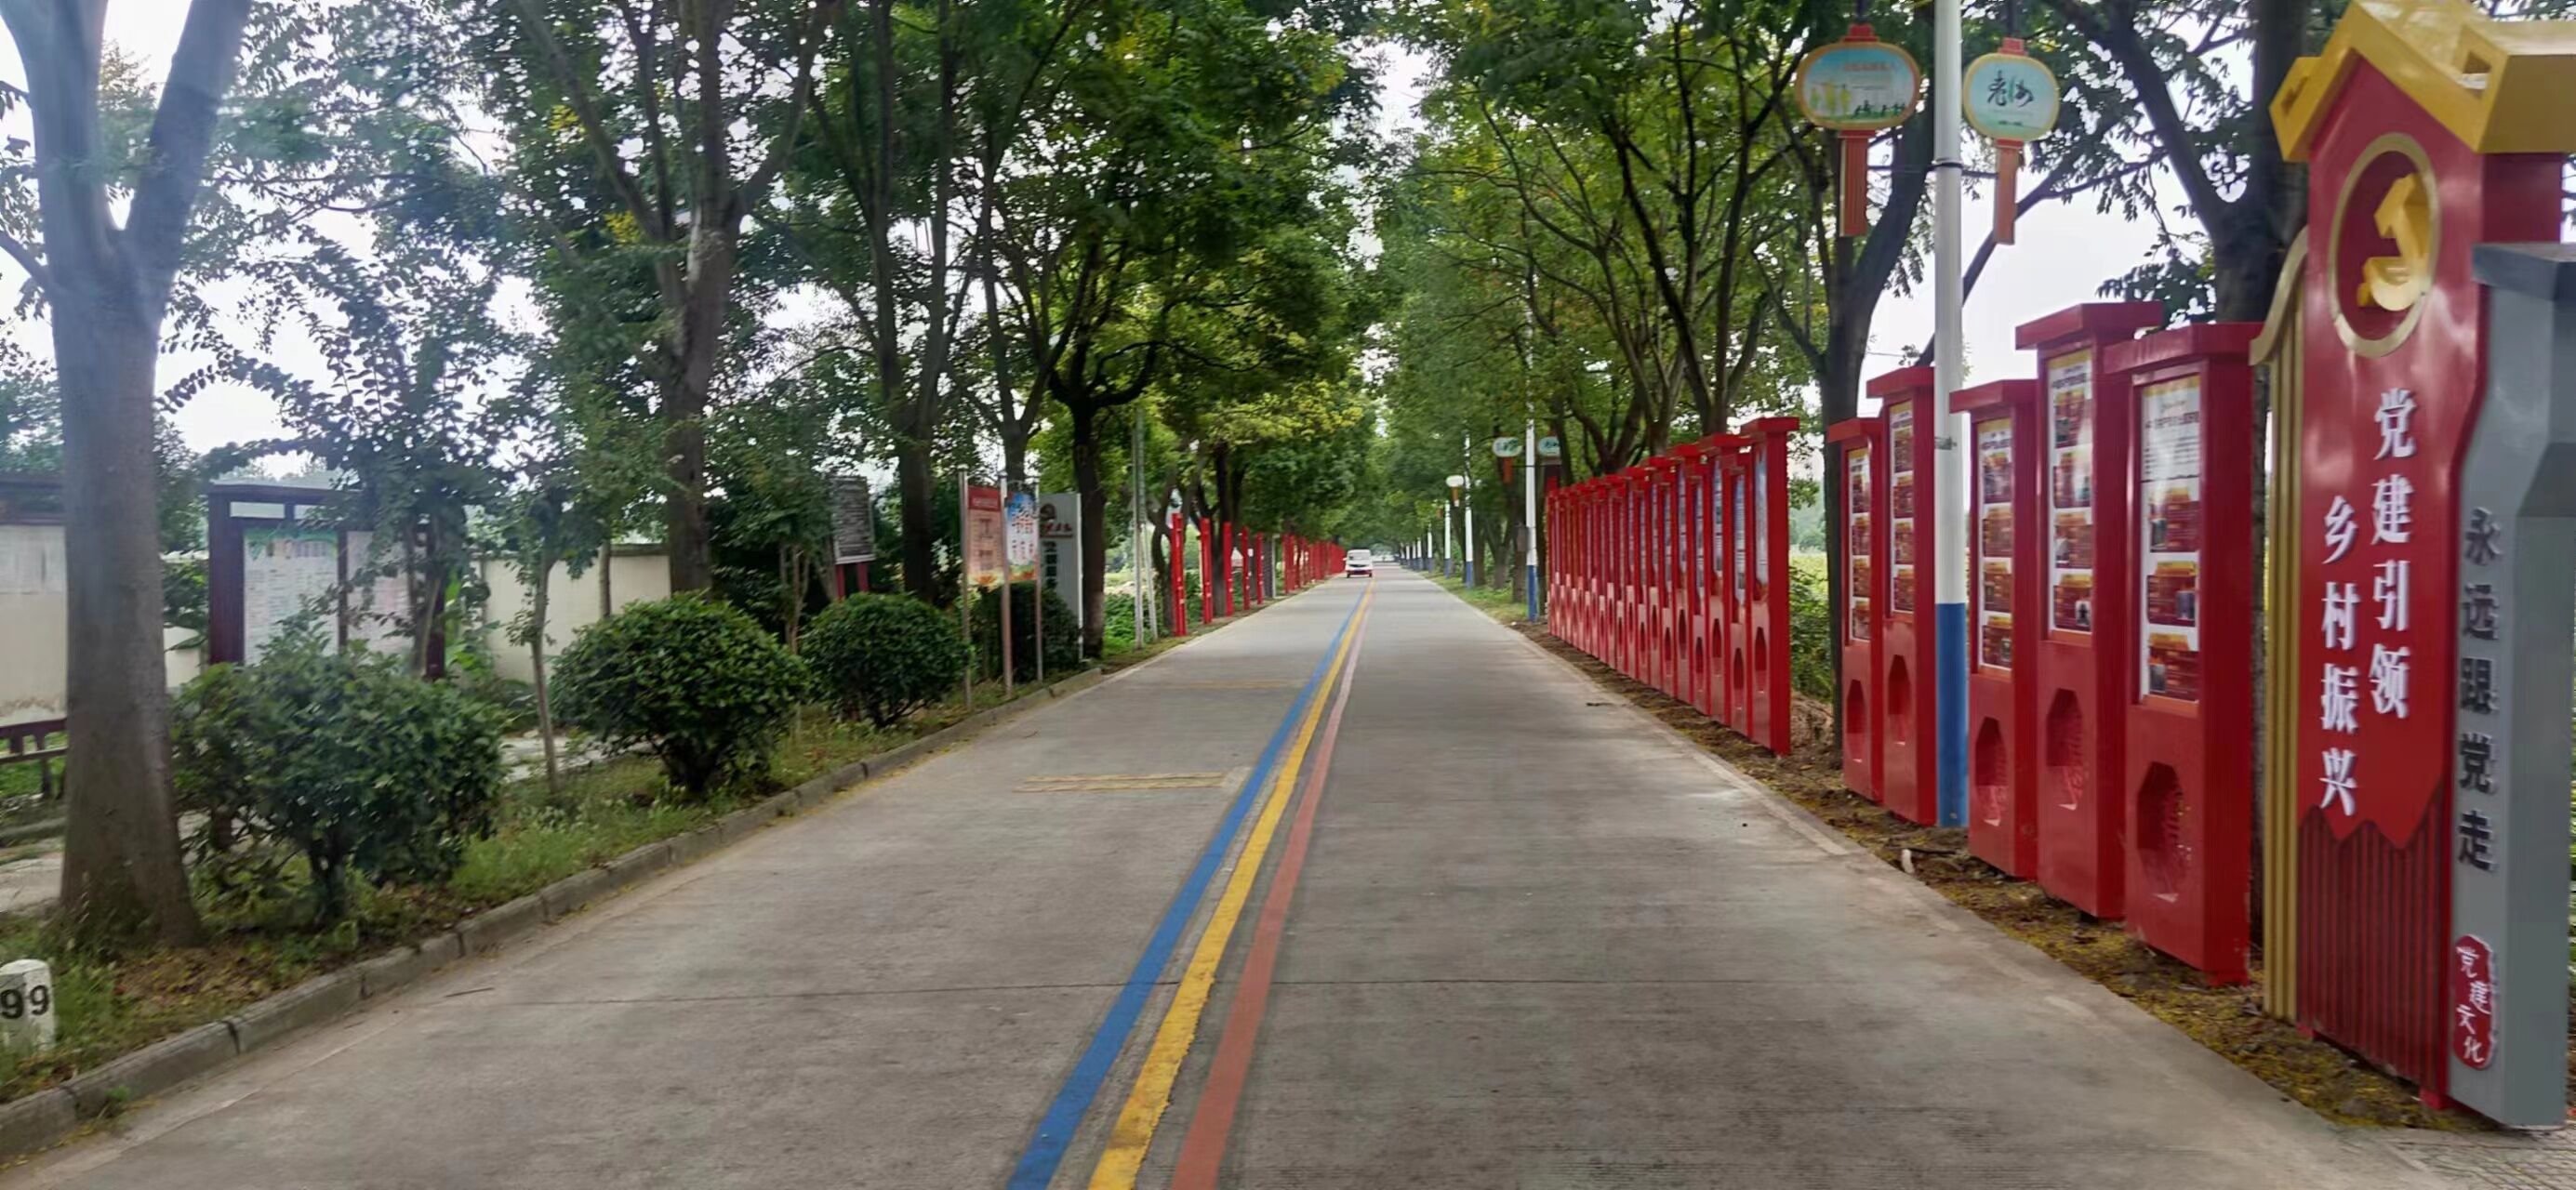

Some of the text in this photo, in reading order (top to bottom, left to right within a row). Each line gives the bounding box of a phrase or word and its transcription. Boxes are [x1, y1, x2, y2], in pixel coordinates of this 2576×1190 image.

[2319, 494, 2361, 816] 乡村振兴
[2369, 387, 2419, 720] 党建引领
[2458, 507, 2502, 872] 永远跟党走
[0, 985, 50, 1020] 99
[2455, 945, 2491, 1063] 党建文化
